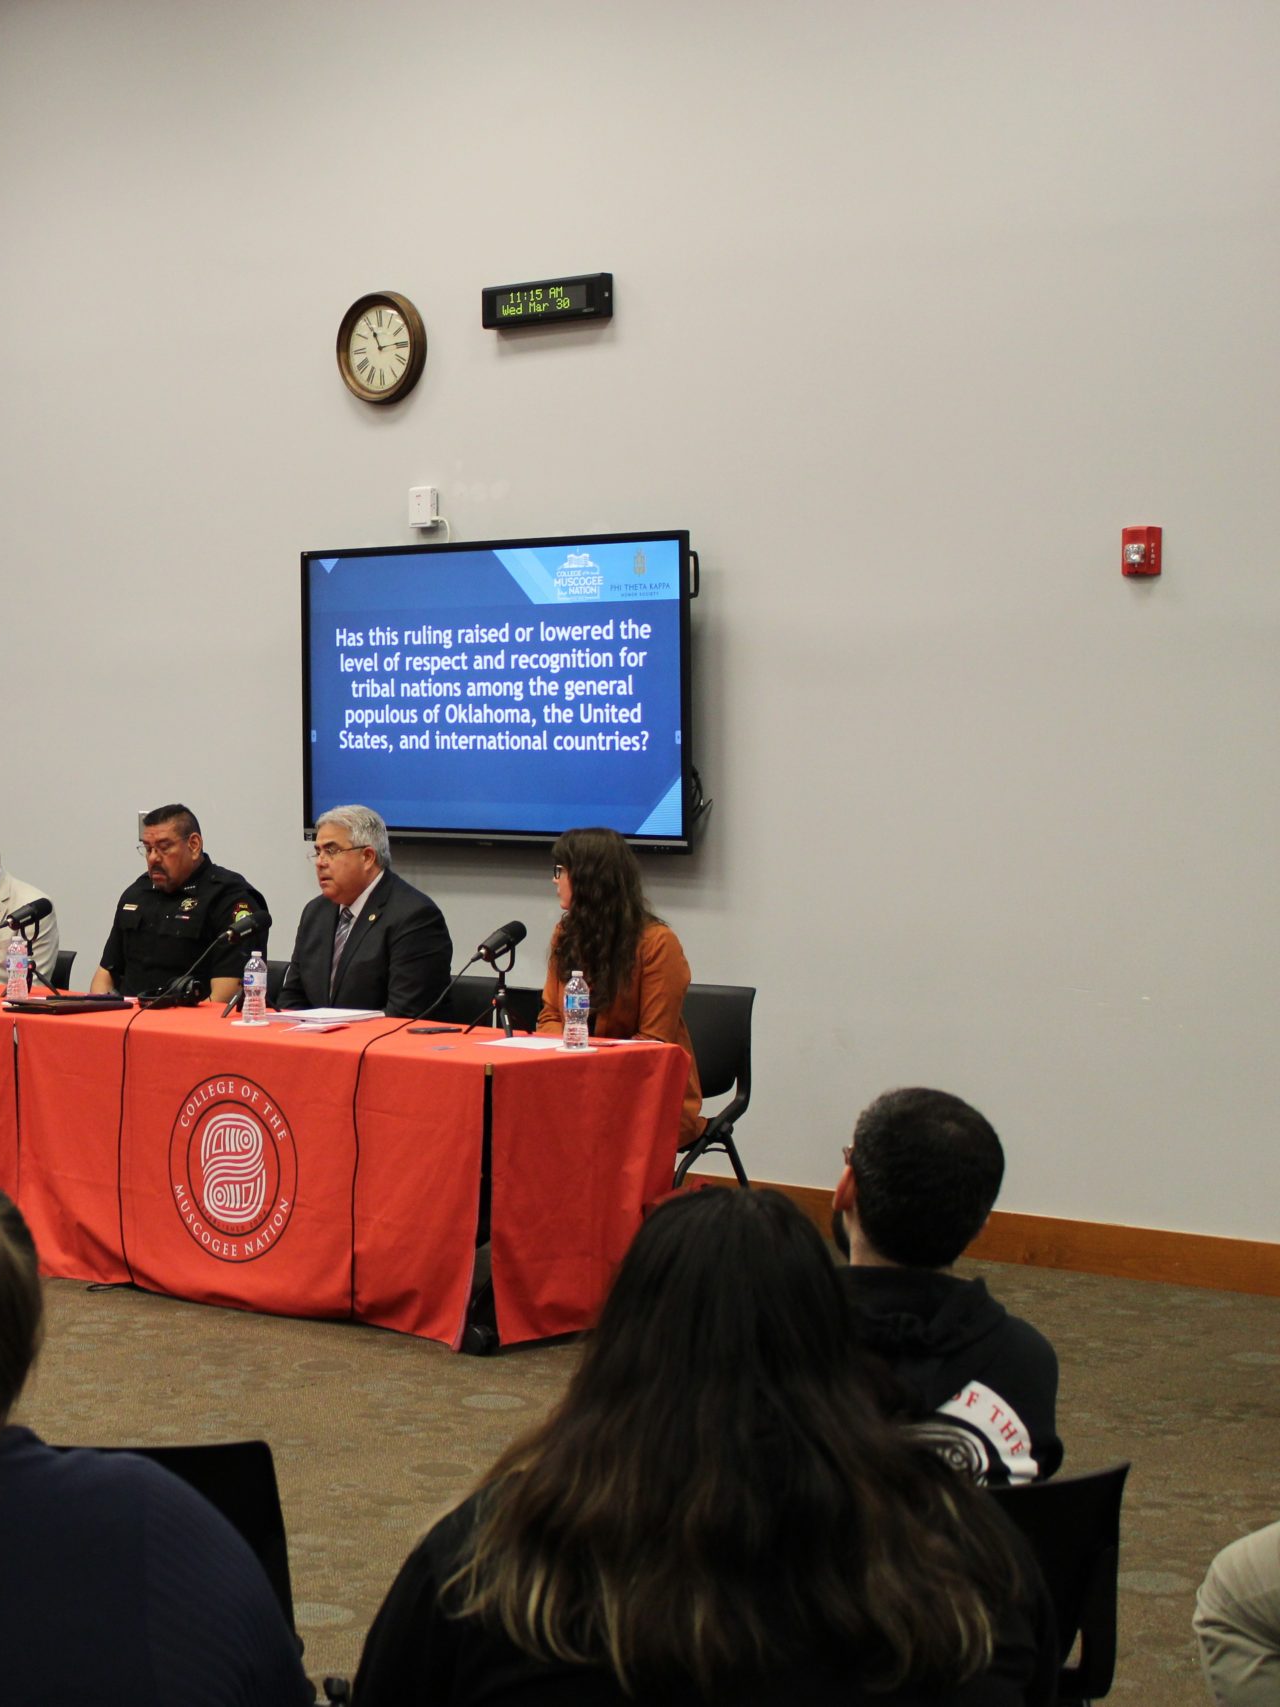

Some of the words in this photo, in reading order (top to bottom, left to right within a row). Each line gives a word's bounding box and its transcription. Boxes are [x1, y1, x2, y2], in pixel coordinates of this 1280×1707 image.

[502, 303, 522, 316] Wed
[529, 301, 549, 313] Mar
[556, 297, 570, 310] 30
[510, 288, 543, 304] 11:15
[549, 286, 563, 299] AM
[554, 576, 604, 587] MUSCOGEE
[568, 586, 597, 595] NATION
[610, 584, 621, 592] PHI
[624, 583, 647, 591] THETA
[649, 582, 671, 590] KAPPA
[335, 628, 364, 647] Has
[368, 626, 399, 646] this
[404, 625, 452, 649] ruling
[457, 623, 509, 644] raised
[515, 626, 534, 642] or
[540, 619, 614, 642] lowered
[619, 618, 652, 640] the
[340, 652, 379, 672] level
[383, 652, 401, 672] of
[405, 652, 468, 676] respect
[473, 649, 505, 670] and
[510, 648, 613, 674] recognition
[619, 646, 648, 668] for
[351, 678, 395, 698] tribal
[400, 678, 461, 697] nations
[467, 680, 524, 701] among
[529, 675, 559, 696] the
[564, 674, 633, 701] general
[345, 704, 418, 728] populous
[423, 703, 441, 724] of
[445, 703, 537, 728] Oklahoma,
[543, 703, 574, 723] the
[579, 702, 642, 723] United
[339, 730, 393, 753] States,
[399, 730, 430, 750] and
[435, 730, 547, 750] international
[553, 730, 649, 751] countries?
[180, 1081, 234, 1128] COLLEGE
[241, 1085, 260, 1103] OF
[263, 1103, 287, 1141] THE
[175, 1184, 237, 1257] MUSCOGEE
[244, 1199, 289, 1256] NATION
[990, 1404, 1025, 1456] THE
